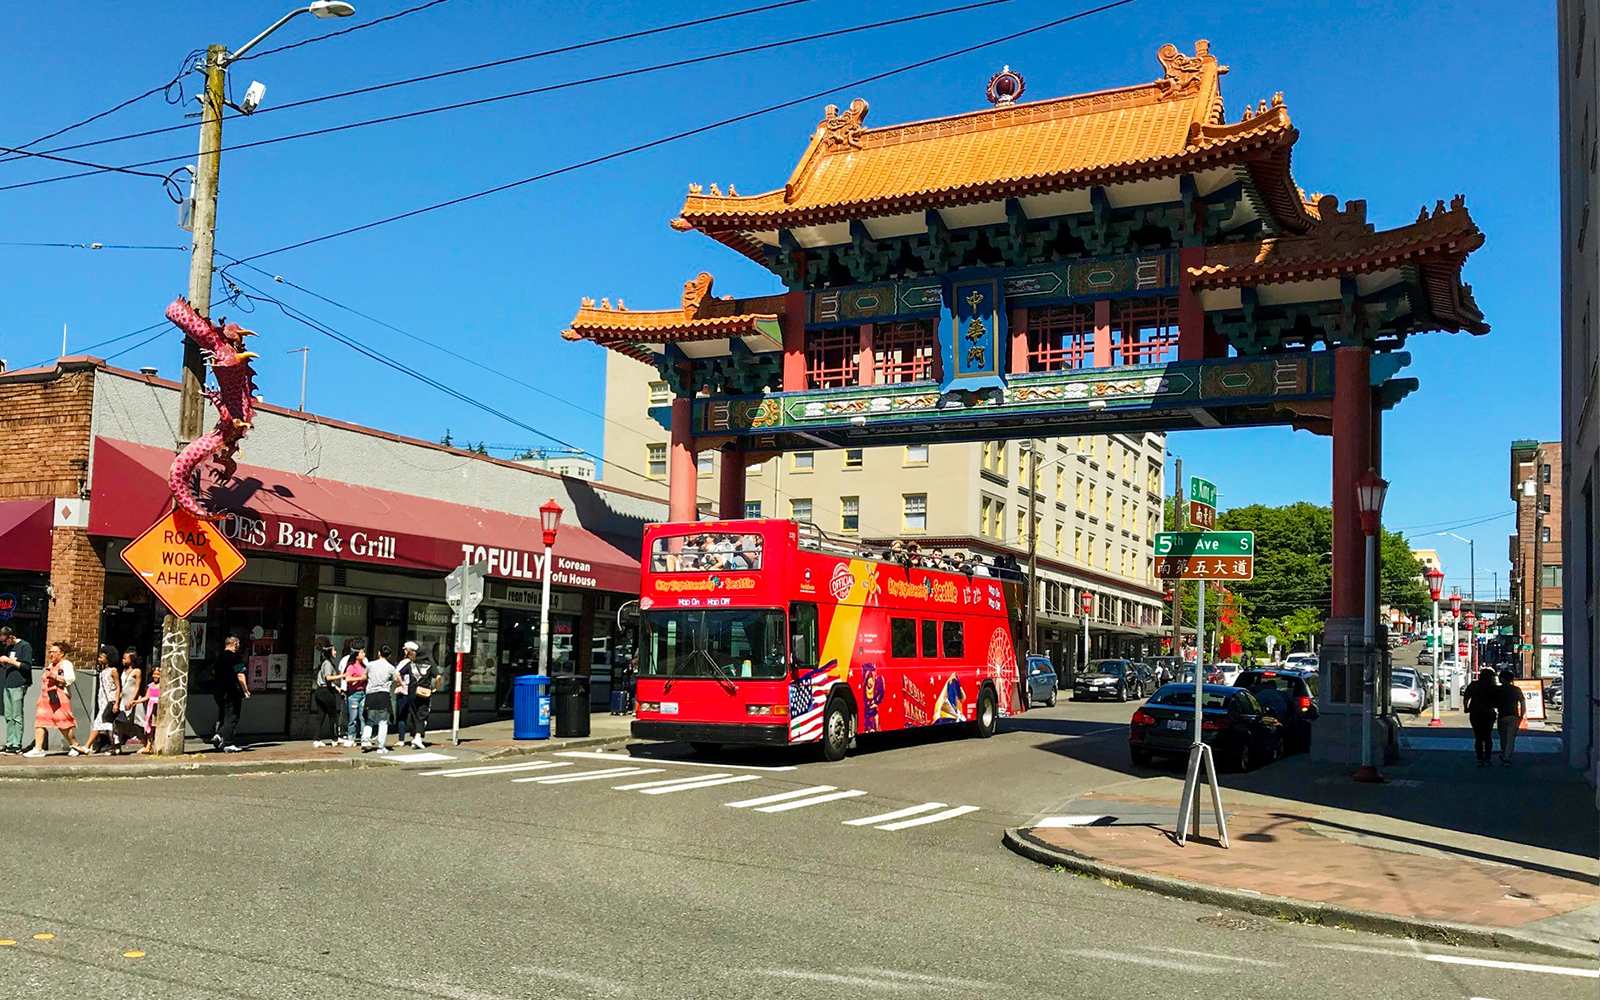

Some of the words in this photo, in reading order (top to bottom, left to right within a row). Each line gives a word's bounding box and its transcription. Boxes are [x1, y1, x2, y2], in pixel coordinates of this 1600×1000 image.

[1192, 483, 1197, 496] S
[164, 530, 207, 545] ROAD
[276, 522, 319, 549] Bar
[323, 529, 343, 552] &
[350, 532, 396, 559] Grill
[1159, 535, 1184, 553] 5th
[1195, 538, 1219, 550] Ave
[1240, 538, 1249, 550] S
[162, 552, 206, 567] WORK
[462, 544, 545, 579] TOFULLY
[558, 558, 591, 572] Korean
[1157, 559, 1249, 575] 南第五大道
[156, 571, 211, 587] AHEAD
[550, 570, 568, 583] ofu
[569, 573, 597, 587] House
[725, 577, 755, 590] Seattle
[832, 575, 855, 592] OFFICIAL
[933, 578, 958, 604] Seattle
[678, 598, 690, 606] Hop
[691, 598, 699, 606] On
[707, 598, 719, 606] Hop
[720, 597, 730, 606] Off
[1458, 646, 1468, 654] STO
